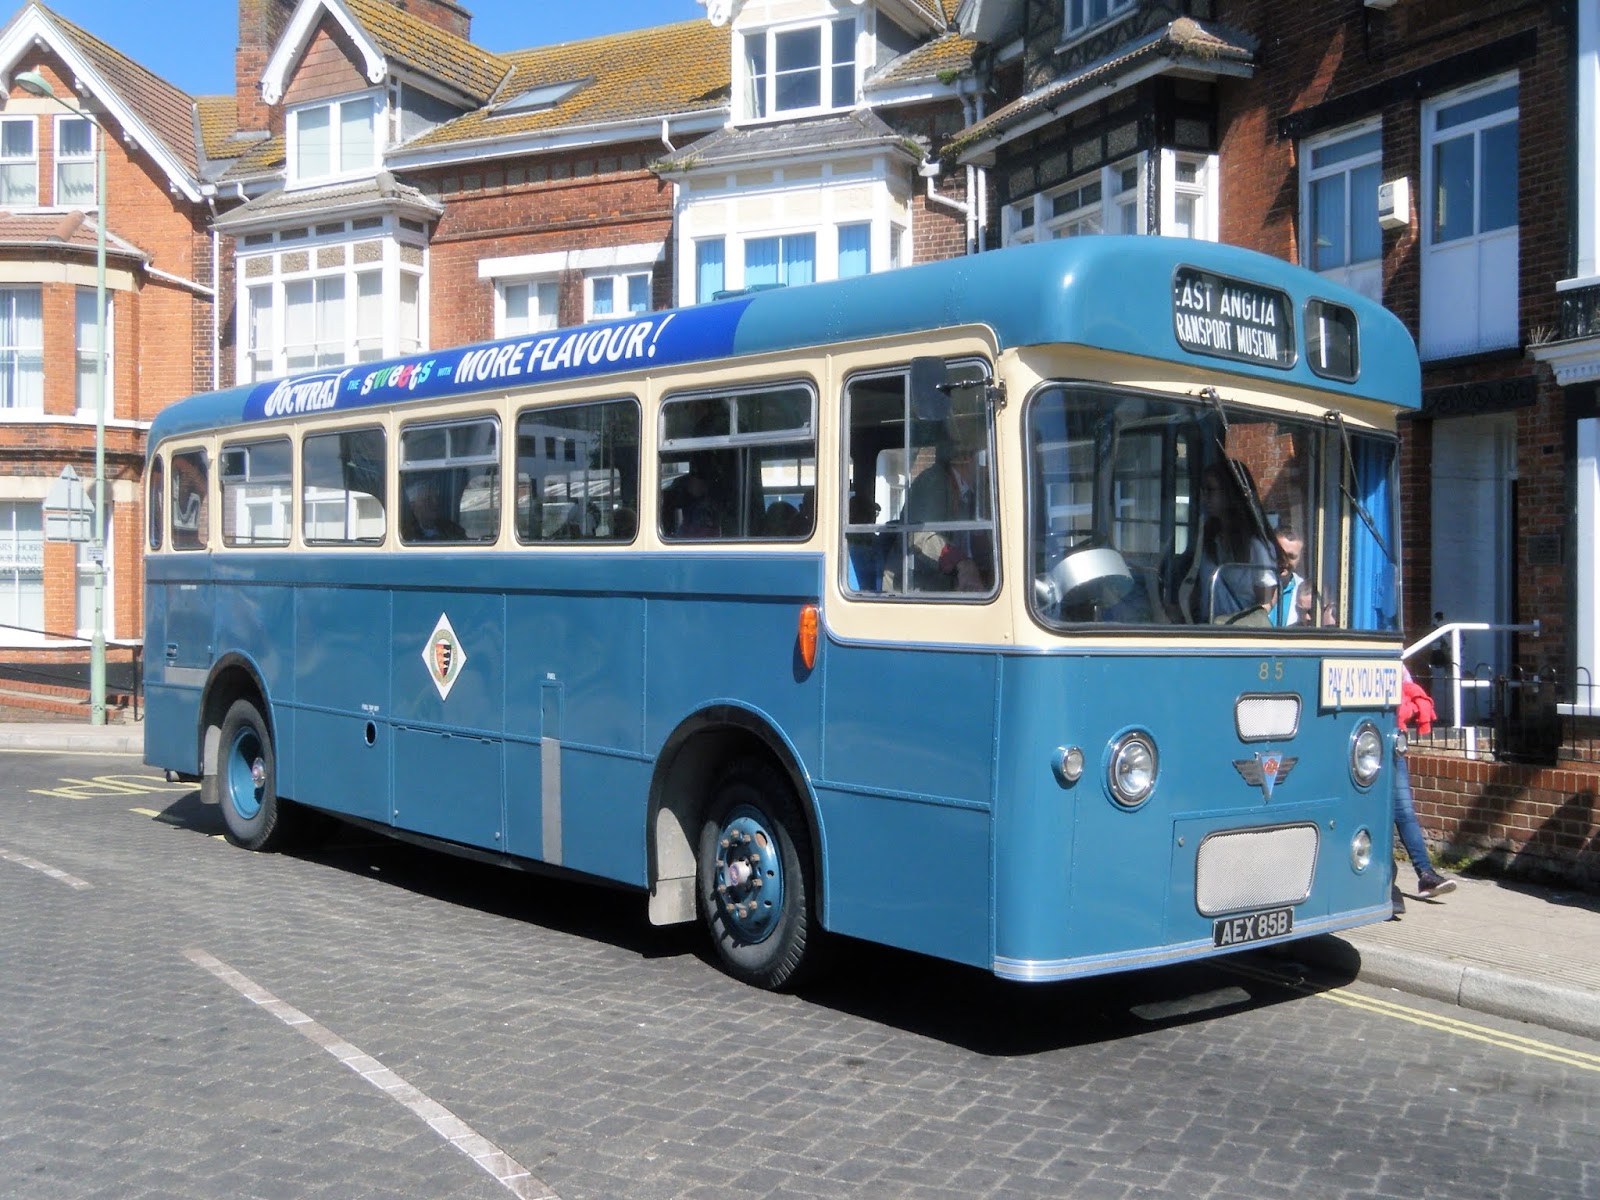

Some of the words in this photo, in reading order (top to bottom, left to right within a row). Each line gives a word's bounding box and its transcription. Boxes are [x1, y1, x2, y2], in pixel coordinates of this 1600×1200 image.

[1220, 288, 1275, 327] ANGLIA
[347, 379, 361, 391] THE
[454, 341, 534, 384] MORE
[527, 313, 677, 373] FLAVOUR!
[1176, 312, 1232, 351] RANSPORT
[1236, 325, 1278, 361] MUSEUM
[1328, 667, 1344, 698] PAY
[1345, 667, 1355, 698] AS
[1357, 667, 1374, 698] YOU
[1375, 668, 1397, 698] ENTER
[1221, 917, 1255, 945] AEX
[1257, 911, 1289, 938] 85B
